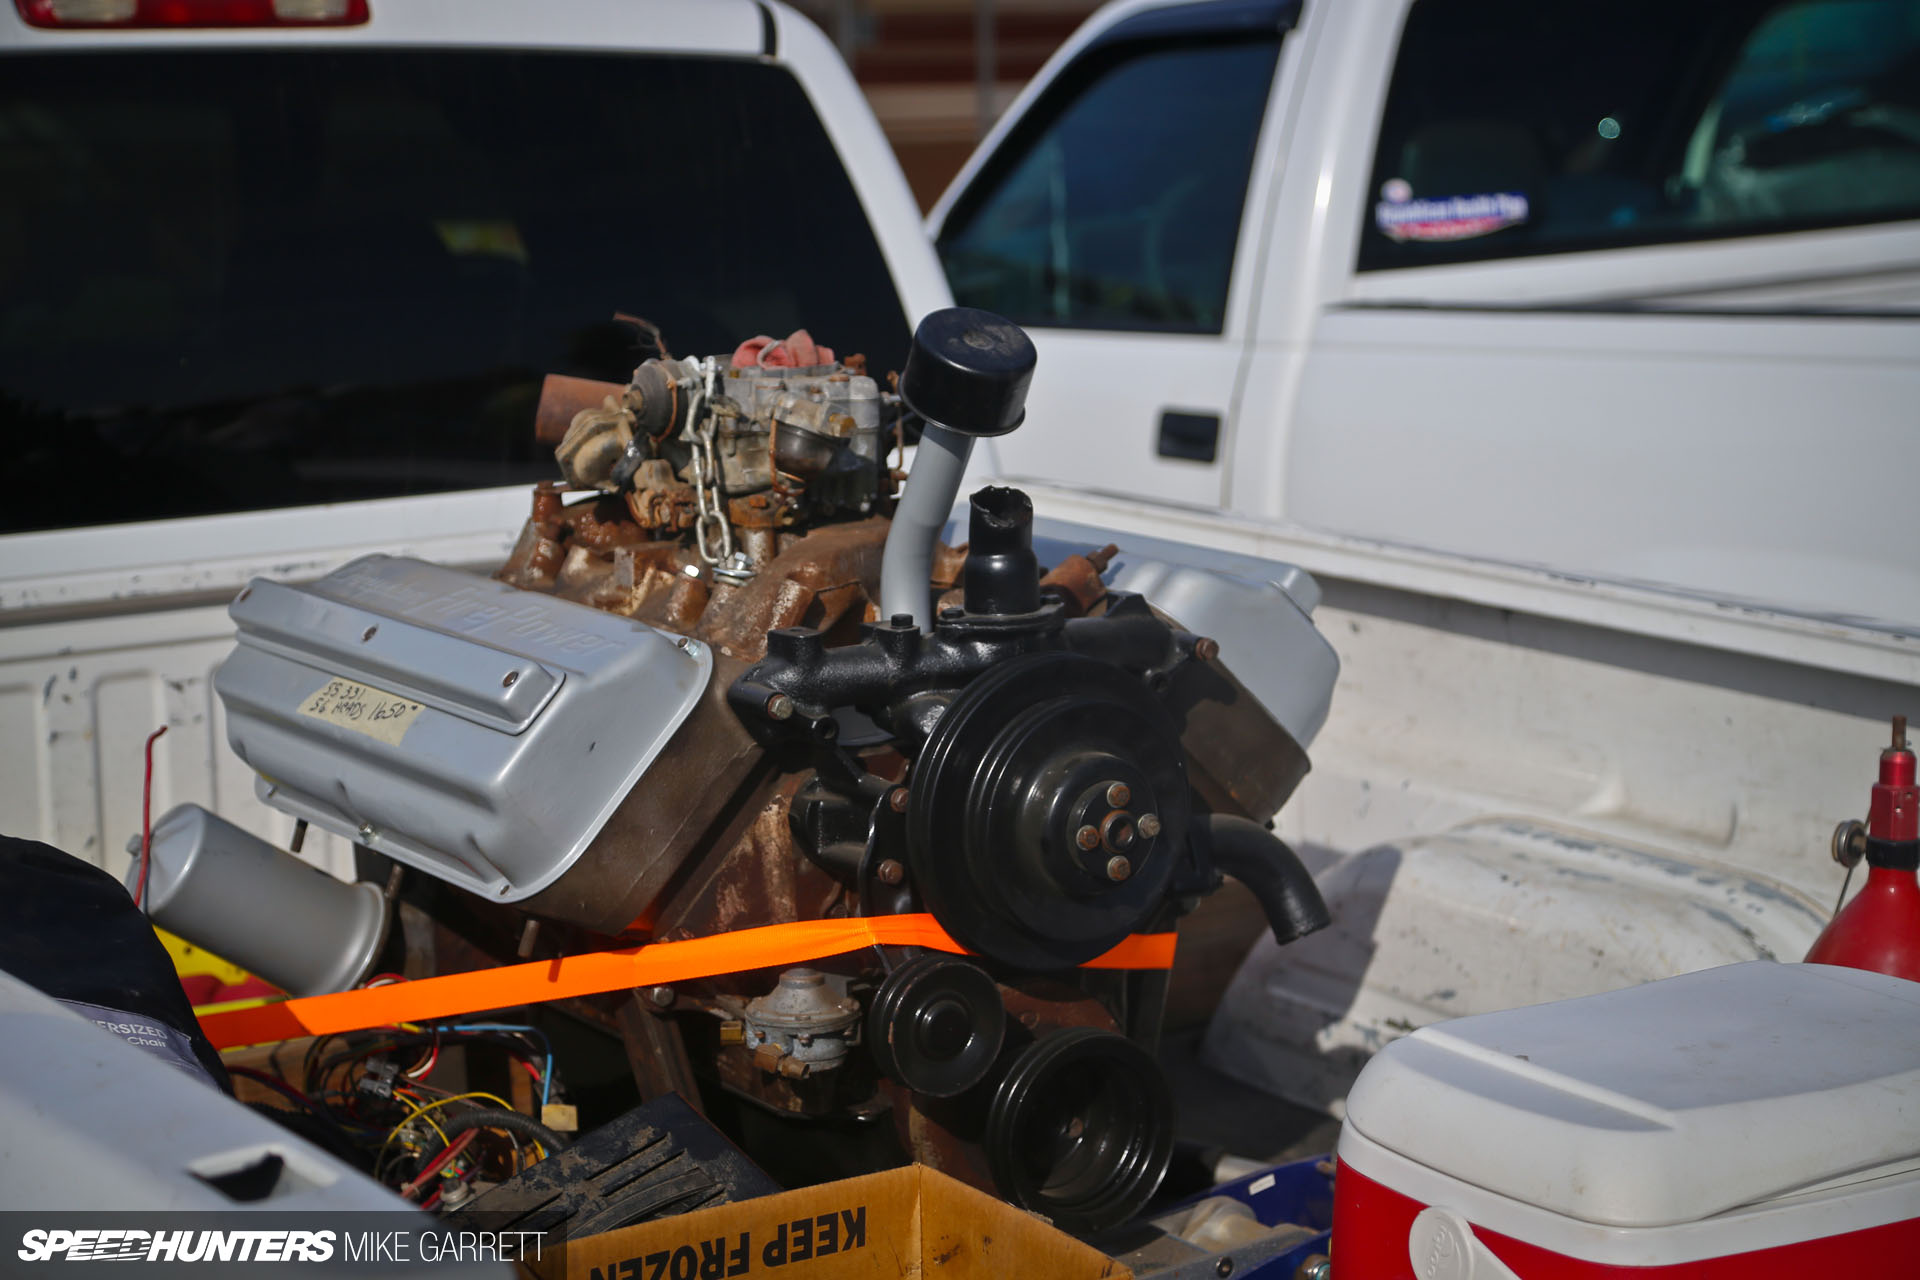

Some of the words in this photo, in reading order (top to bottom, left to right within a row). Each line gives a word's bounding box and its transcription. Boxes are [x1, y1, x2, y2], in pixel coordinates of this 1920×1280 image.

[322, 681, 343, 697] 55
[340, 685, 367, 700] 331
[127, 1036, 166, 1048] Chair
[762, 1206, 866, 1268] KEEP
